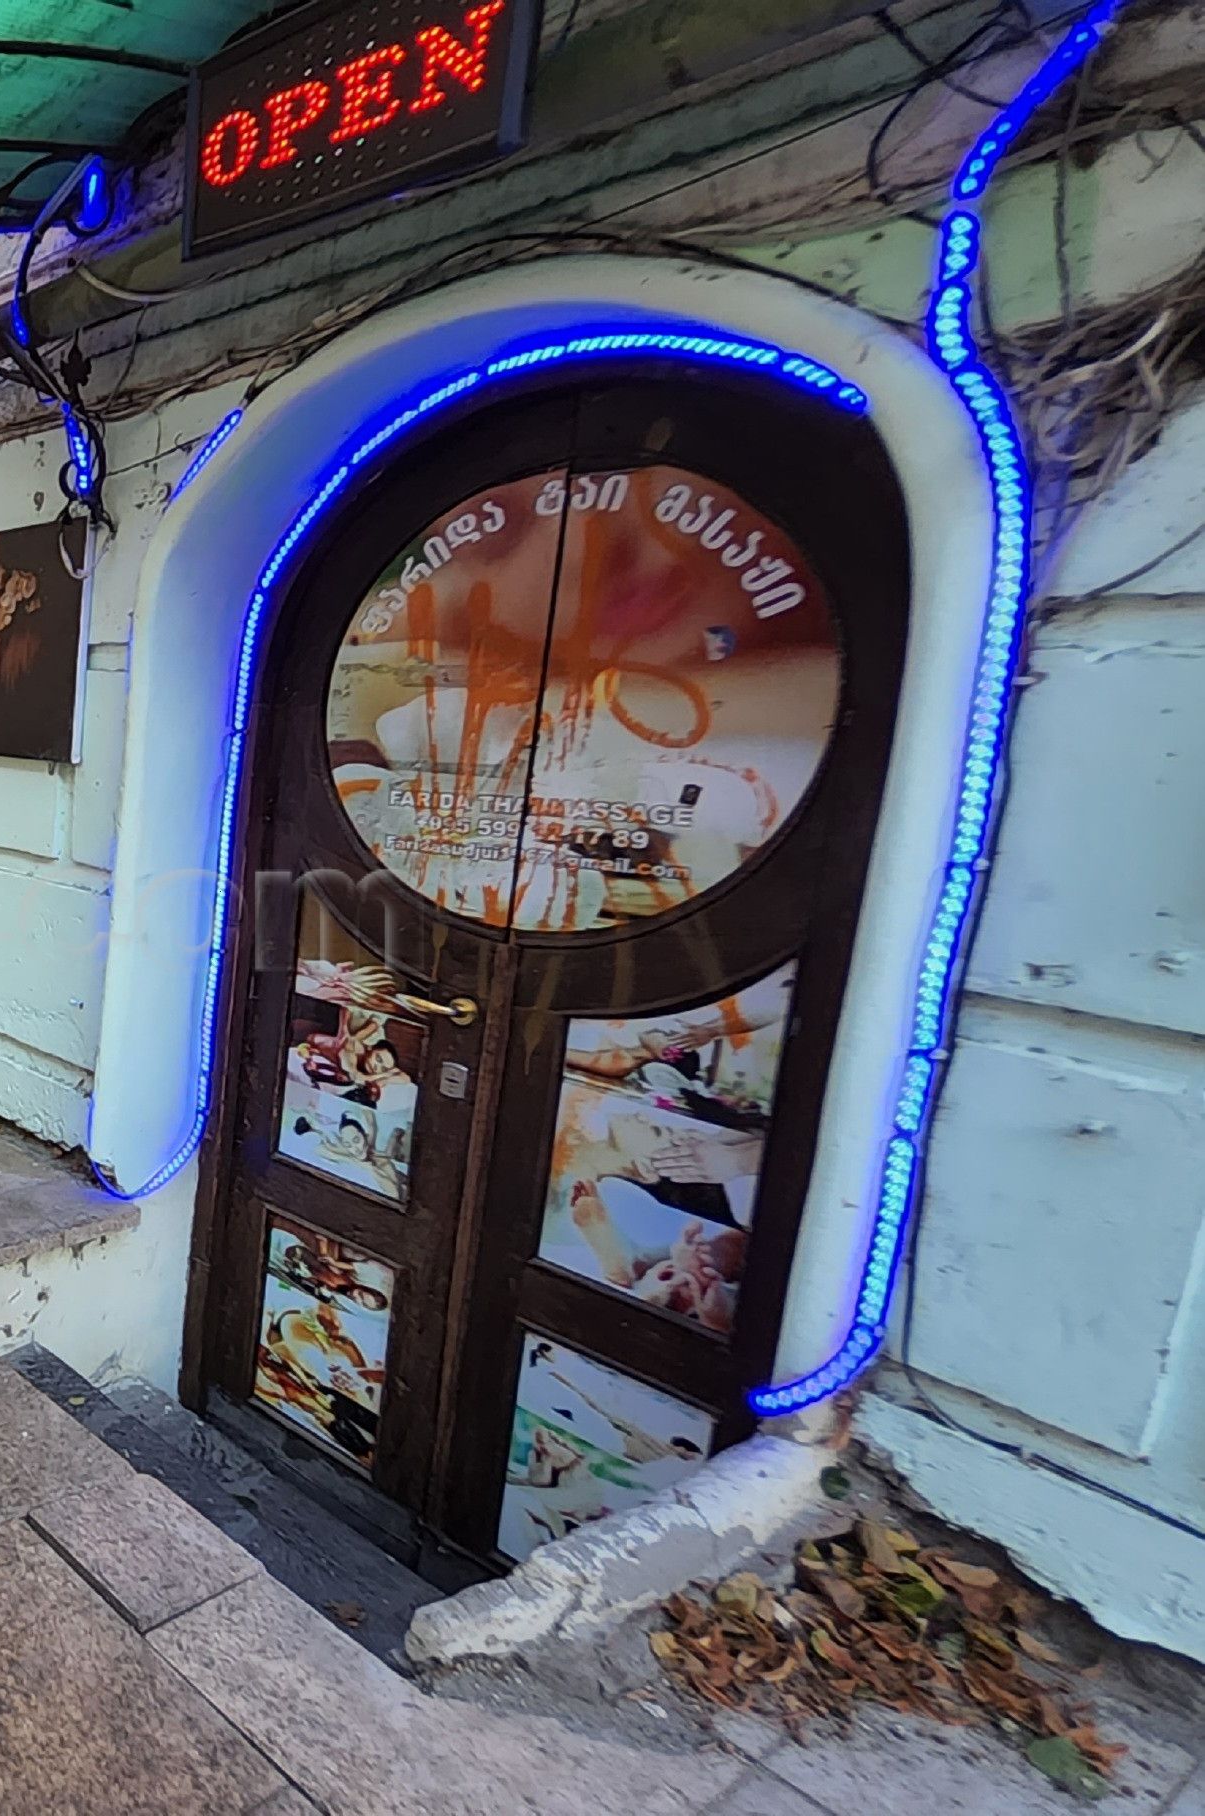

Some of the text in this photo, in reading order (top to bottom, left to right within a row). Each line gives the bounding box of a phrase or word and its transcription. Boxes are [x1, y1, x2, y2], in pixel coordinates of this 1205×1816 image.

[200, 0, 506, 188] OPEN
[360, 474, 806, 634] ფარიდა ტაი მასაჟი
[389, 790, 471, 811] FARIDA
[478, 818, 521, 839] 599
[612, 829, 650, 850] 89
